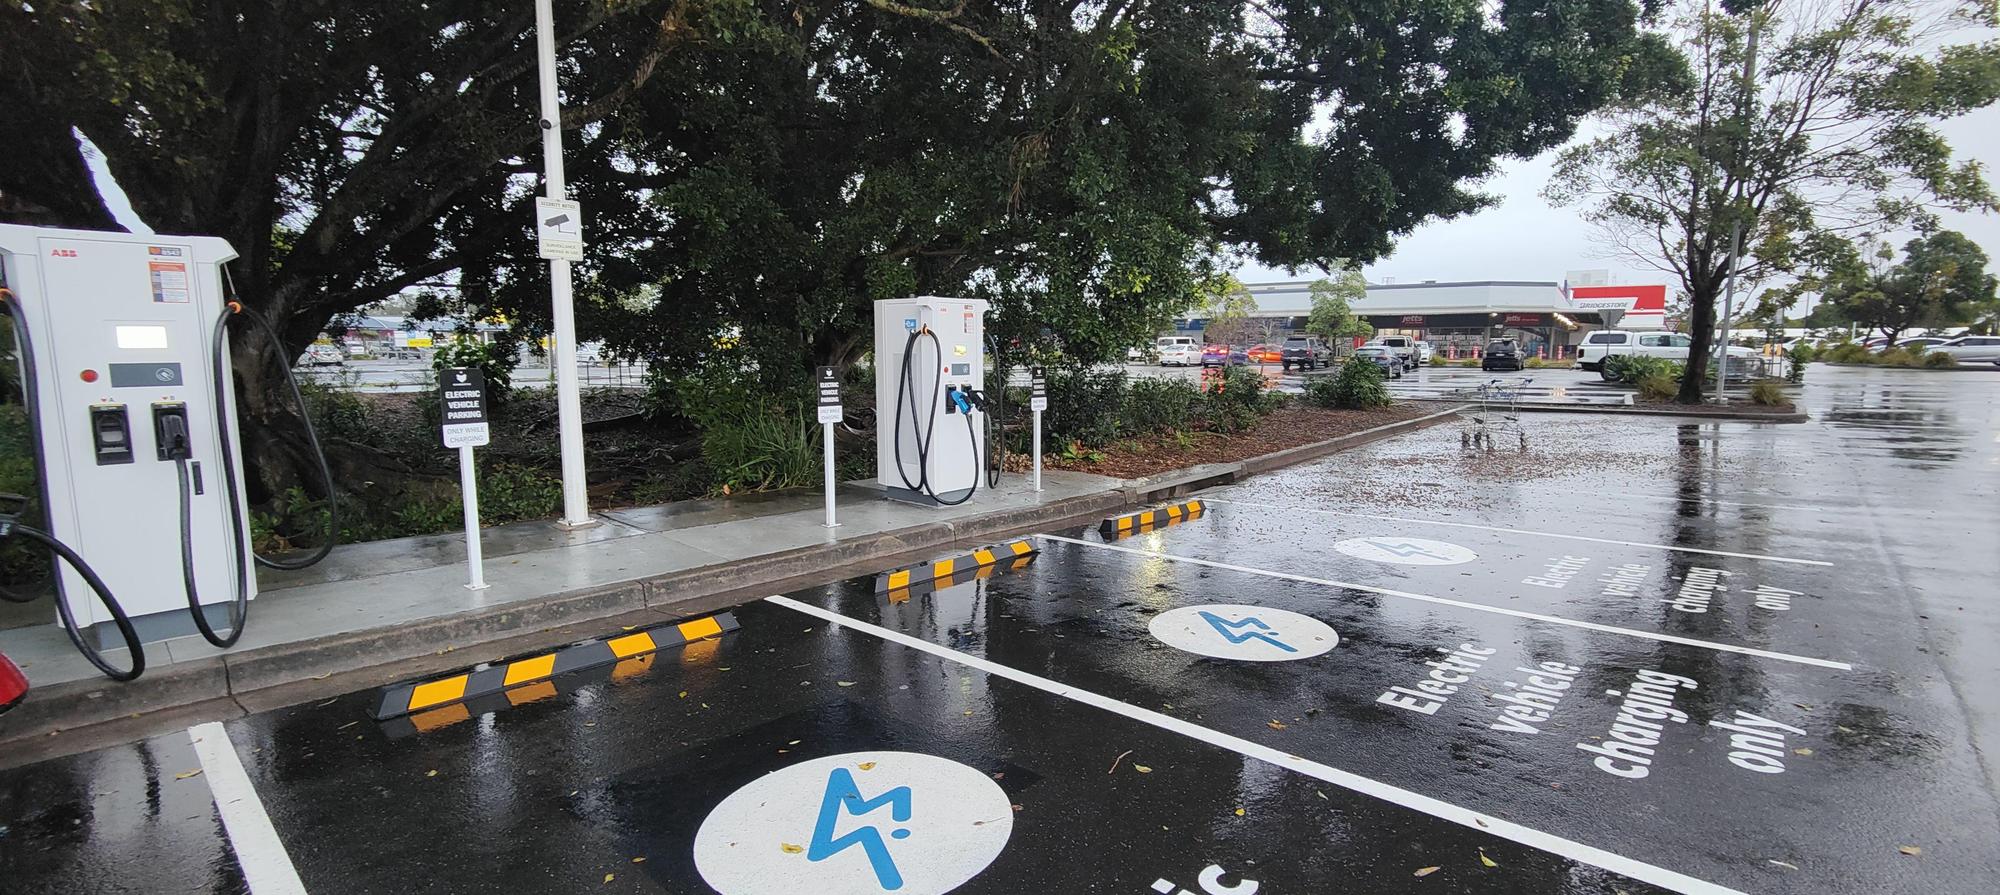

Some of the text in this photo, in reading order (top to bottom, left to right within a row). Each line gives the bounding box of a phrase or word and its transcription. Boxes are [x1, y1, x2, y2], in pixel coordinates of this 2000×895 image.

[51, 249, 78, 257] ABB
[445, 390, 481, 399] ELECTRIC
[447, 400, 480, 409] VEHICLE
[447, 411, 482, 420] PARKING
[449, 435, 483, 443] CHARGING
[1521, 553, 1591, 590] Electric
[1597, 562, 1652, 597] vehicle
[1660, 566, 1733, 613] charging
[1741, 584, 1805, 611] only
[1375, 641, 1497, 716] Electric
[1490, 660, 1582, 736] vehicle
[1576, 668, 1699, 779] charging
[1709, 709, 1807, 774] only
